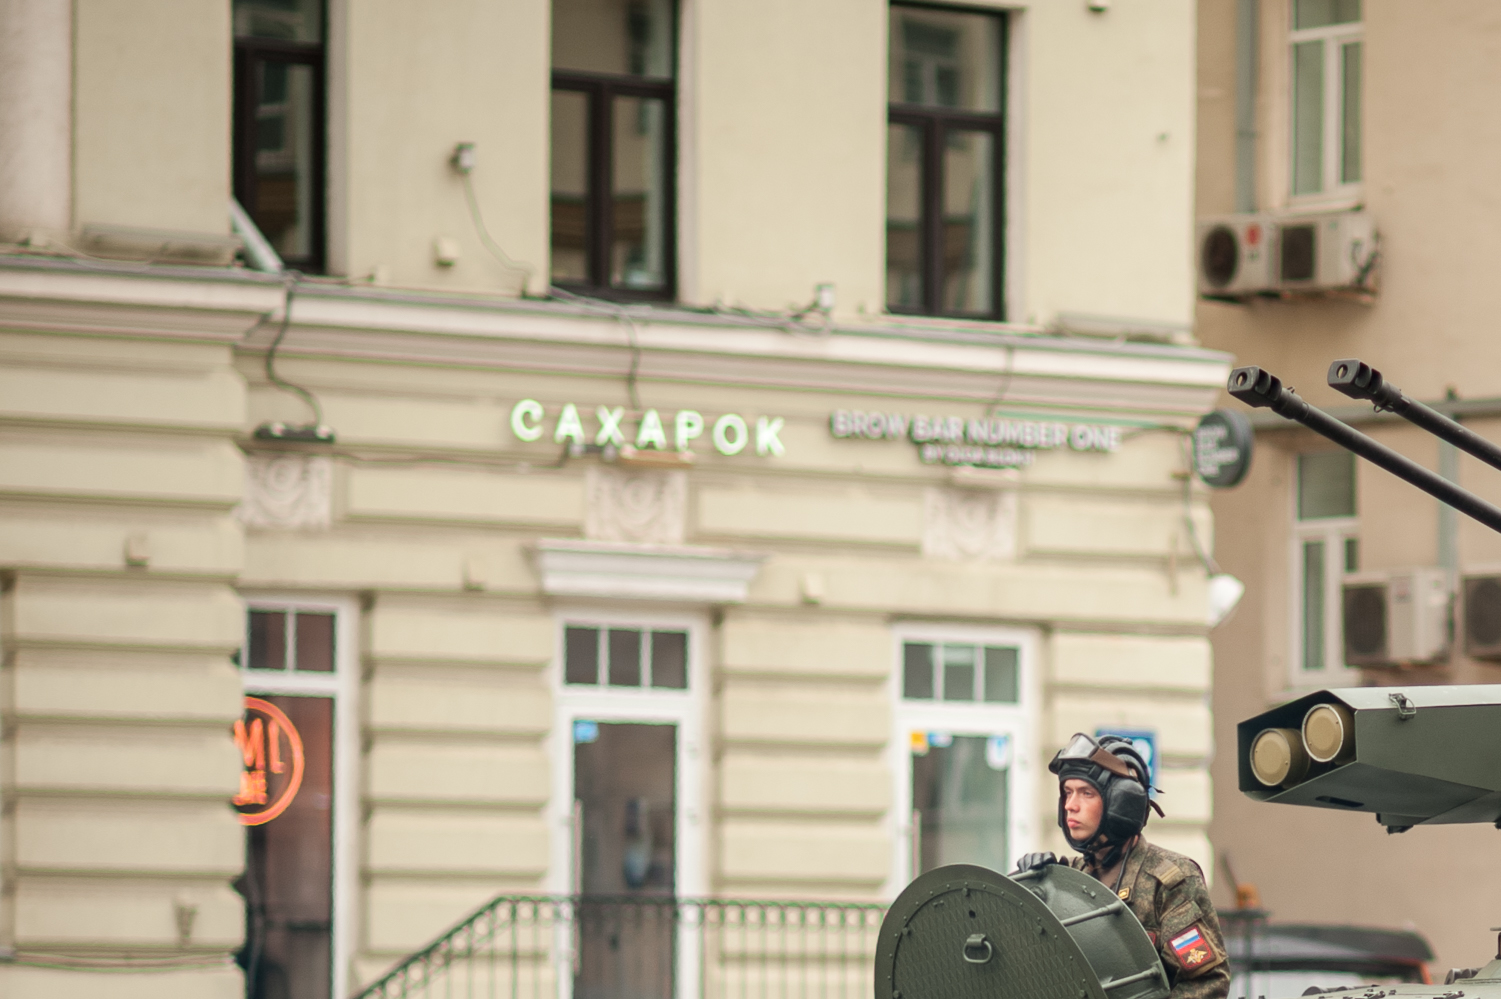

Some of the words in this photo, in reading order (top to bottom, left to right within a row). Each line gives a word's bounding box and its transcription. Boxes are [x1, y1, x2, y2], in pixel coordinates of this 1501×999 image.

[510, 398, 786, 457] САХАРОК
[830, 408, 907, 439] BROW
[910, 414, 964, 444] BAR
[965, 417, 1068, 450] NUMBER
[1067, 424, 1122, 452] ONE
